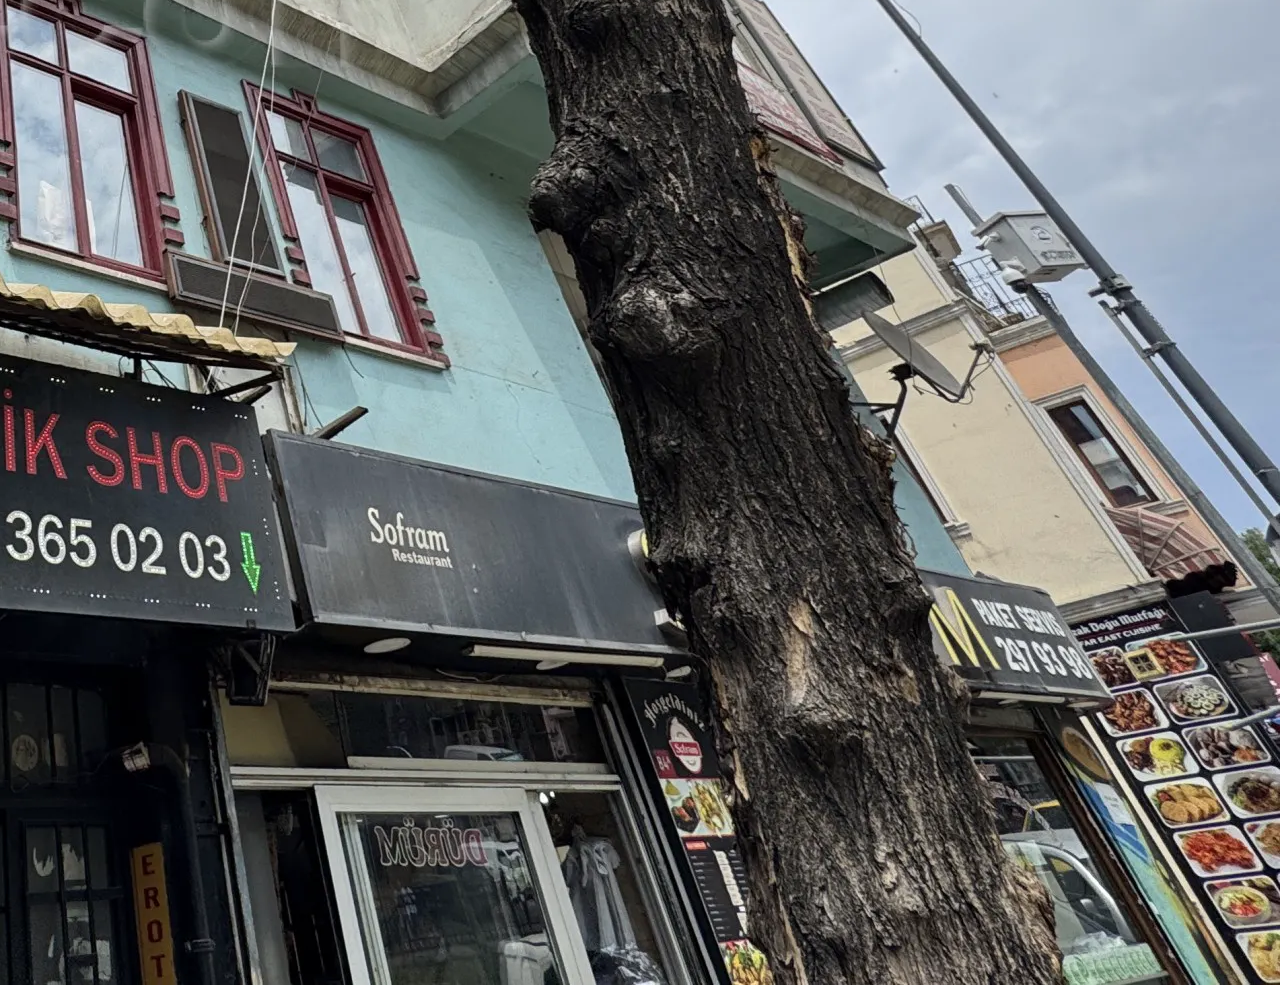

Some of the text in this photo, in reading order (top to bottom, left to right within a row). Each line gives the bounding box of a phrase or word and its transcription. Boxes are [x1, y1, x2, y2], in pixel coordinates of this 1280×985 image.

[85, 420, 246, 502] SHOP
[5, 509, 98, 568] 365
[110, 521, 167, 576] 02
[178, 530, 231, 582] 03
[367, 507, 450, 553] Sofram
[391, 548, 453, 569] Restaurant
[972, 598, 1021, 630] PAKET
[1071, 625, 1091, 636] zak
[1098, 632, 1122, 644] EAST
[1122, 623, 1162, 638] CUISINE
[994, 636, 1093, 680] 297 93 98
[140, 853, 166, 978] EROT
